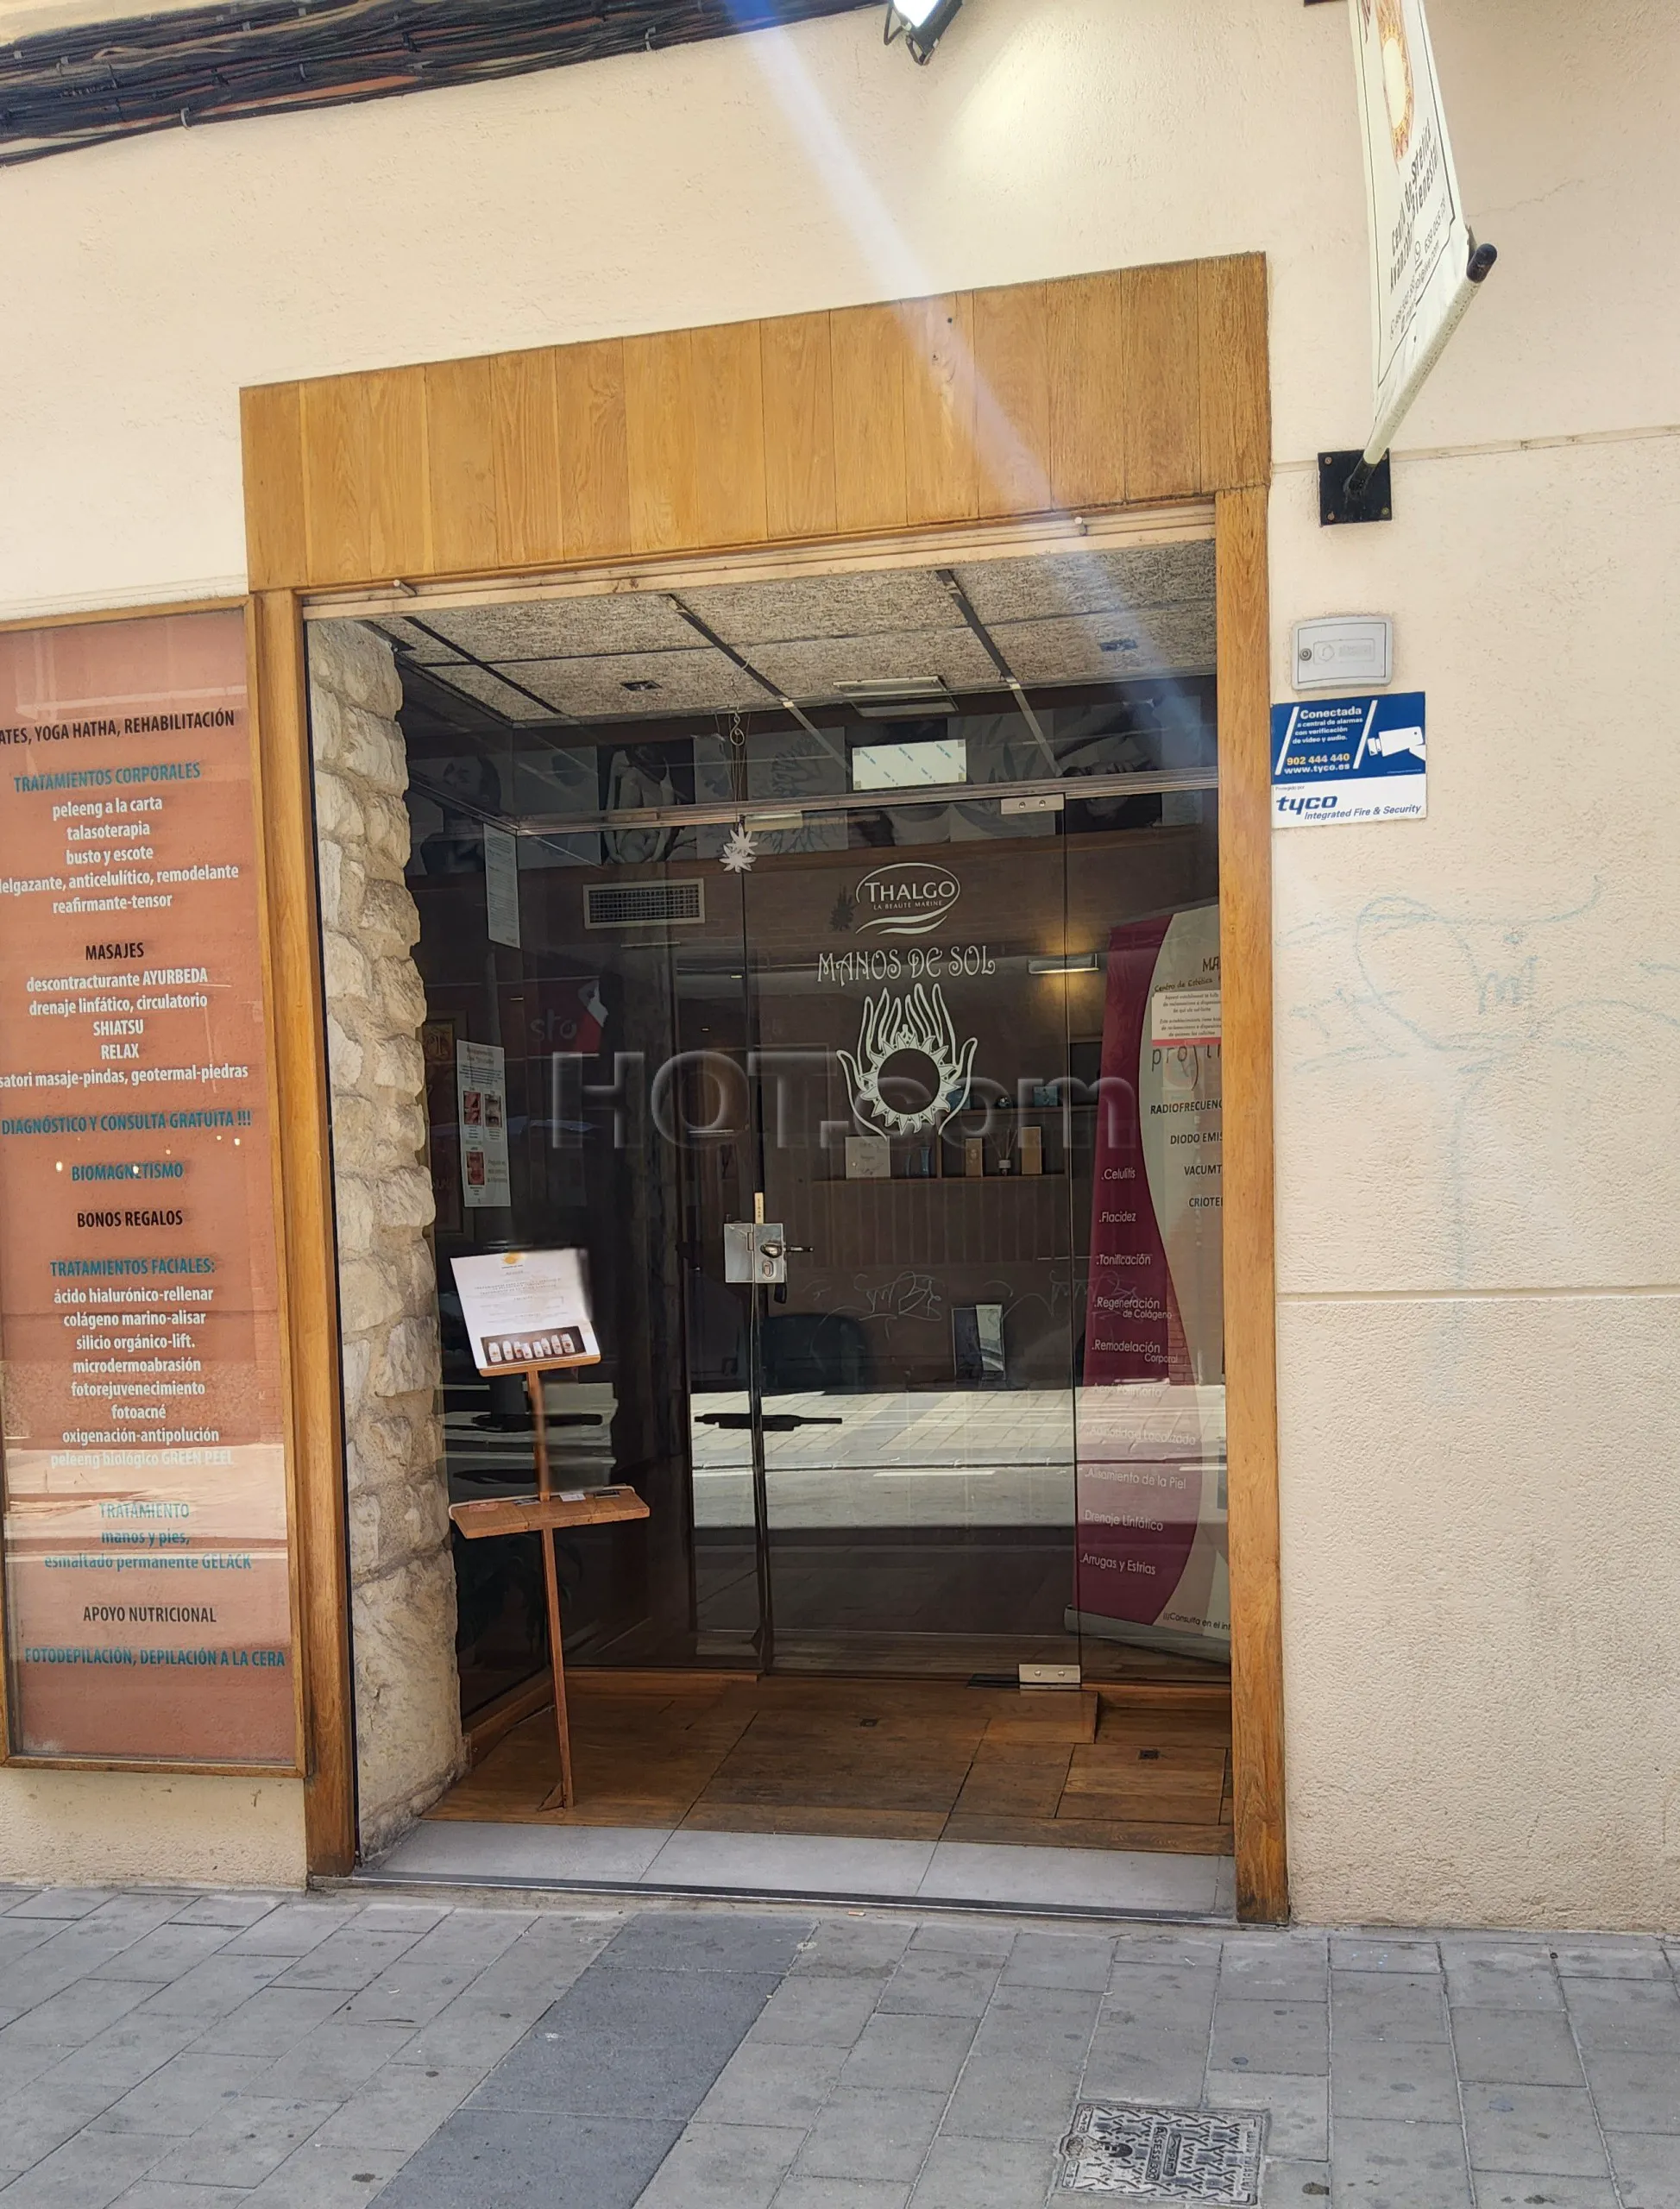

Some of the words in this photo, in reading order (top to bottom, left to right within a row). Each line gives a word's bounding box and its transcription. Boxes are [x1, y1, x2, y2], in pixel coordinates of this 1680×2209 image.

[1300, 706, 1362, 720] Conectada
[1302, 719, 1326, 727] central
[1337, 716, 1363, 725] alarmas
[35, 724, 69, 742] YOGA
[72, 720, 121, 739] HATHA,
[124, 708, 235, 734] REHABILITACIÓN
[1308, 726, 1348, 735] verificación
[1321, 736, 1326, 745] y
[1287, 755, 1306, 766] 902
[1308, 754, 1328, 764] 444
[1330, 752, 1350, 763] 440
[14, 768, 112, 793] TRATAMIENTOS
[115, 762, 201, 784] CORPORALES
[1284, 763, 1350, 775] www.tyco.es
[53, 799, 103, 821] peleeng
[105, 802, 113, 815] a
[116, 797, 128, 814] la
[129, 796, 163, 813] carta
[1276, 795, 1338, 815] tyco
[1304, 809, 1350, 821] Integrated
[1353, 807, 1370, 817] Fire
[1373, 805, 1381, 816] &
[1383, 802, 1422, 815] Security
[66, 821, 150, 842] talasoterapia
[66, 848, 101, 865] busto
[104, 851, 110, 866] y
[113, 845, 154, 862] escote
[68, 869, 154, 890] anticelulítico,
[157, 865, 239, 884] remodelante
[865, 881, 955, 903] THALGO
[52, 893, 173, 914] reafirmante-tensor
[85, 941, 144, 960] MASAJES
[817, 949, 901, 986] MANOS
[909, 947, 942, 979] DE
[949, 945, 995, 976] SOL
[26, 972, 140, 992] descontracturante
[142, 967, 208, 985] AYURBEDA
[1154, 982, 1175, 992] Centro
[29, 998, 76, 1017] drenaje
[79, 996, 134, 1014] linfático,
[136, 991, 208, 1012] circulatorio
[93, 1019, 144, 1037] SHIATSU
[100, 1043, 139, 1060] RELAX
[35, 1068, 129, 1089] masaje-pindas,
[131, 1063, 249, 1086] geotermal-piedras
[2, 1114, 86, 1136] DIAGNÓSTICO
[89, 1114, 98, 1131] Y
[100, 1112, 167, 1131] CONSULTA
[169, 1111, 234, 1130] GRATUITA
[237, 1111, 251, 1126] !!!
[1170, 1130, 1199, 1145] DIODO
[71, 1162, 184, 1181] BIOMAGNETISMO
[78, 1211, 122, 1228] BONOS
[124, 1210, 183, 1226] REGALOS
[50, 1259, 148, 1277] TRATAMIENTOS
[151, 1258, 216, 1274] FACIALES:
[53, 1288, 86, 1304] ácido
[89, 1287, 213, 1304] hialurónico-rellenar
[63, 1311, 119, 1329] colágeno
[122, 1311, 206, 1326] marino-alisar
[1123, 1310, 1133, 1318] de
[1134, 1309, 1172, 1321] Colágeno
[76, 1335, 111, 1350] silicio
[113, 1333, 196, 1352] orgánico-lift.
[72, 1358, 201, 1374] microdermoabrasión
[1144, 1353, 1178, 1364] Corporal
[71, 1381, 205, 1399] fotorejuvenecimiento
[111, 1404, 167, 1419] fotoacné
[62, 1427, 219, 1446] oxigenación-antipolución
[51, 1452, 101, 1469] peleeng
[103, 1451, 159, 1468] biológico
[160, 1451, 202, 1466] GREEN
[204, 1450, 234, 1465] PEEL
[1142, 1474, 1155, 1486] de
[1158, 1475, 1167, 1488] la
[1169, 1476, 1186, 1489] Piel
[99, 1503, 190, 1519] TRATAMIENTO
[101, 1530, 146, 1544] manos
[148, 1533, 155, 1549] y
[159, 1527, 190, 1547] pies,
[44, 1553, 114, 1569] esmaltado
[116, 1557, 198, 1571] permanente
[201, 1553, 251, 1570] GELACK
[1119, 1561, 1126, 1572] y
[83, 1606, 126, 1622] APOYO
[129, 1606, 217, 1623] NUTRICIONAL
[1213, 1621, 1220, 1629] el
[25, 1647, 136, 1667] FOTODEPILACIÓN,
[140, 1647, 217, 1667] DEPILACIÓN
[219, 1650, 230, 1666] A
[233, 1650, 249, 1667] LA
[251, 1651, 286, 1667] CERA
[1151, 2126, 1167, 2161] AKSESS
[1148, 2162, 1159, 2180] 300
